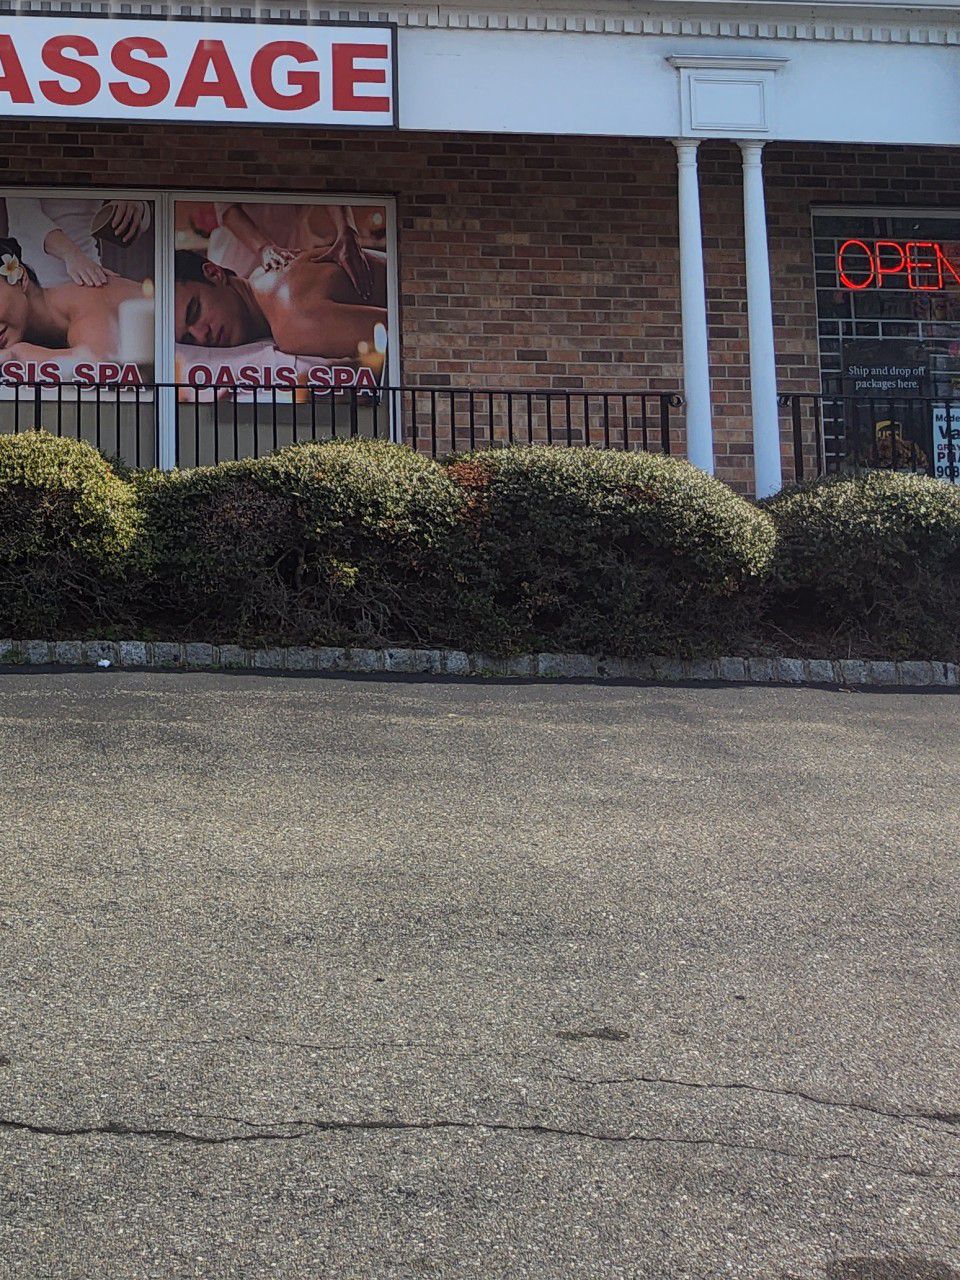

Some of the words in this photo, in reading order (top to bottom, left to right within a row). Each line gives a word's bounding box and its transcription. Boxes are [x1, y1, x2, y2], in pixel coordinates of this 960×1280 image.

[838, 238, 960, 290] OPEN
[73, 362, 146, 392] SPA
[187, 364, 298, 393] OASIS
[307, 366, 381, 396] SPA
[848, 365, 869, 377] Ship
[871, 366, 888, 375] and
[889, 366, 911, 377] drop
[912, 366, 926, 375] off
[855, 379, 896, 390] packages
[897, 379, 920, 388] here.
